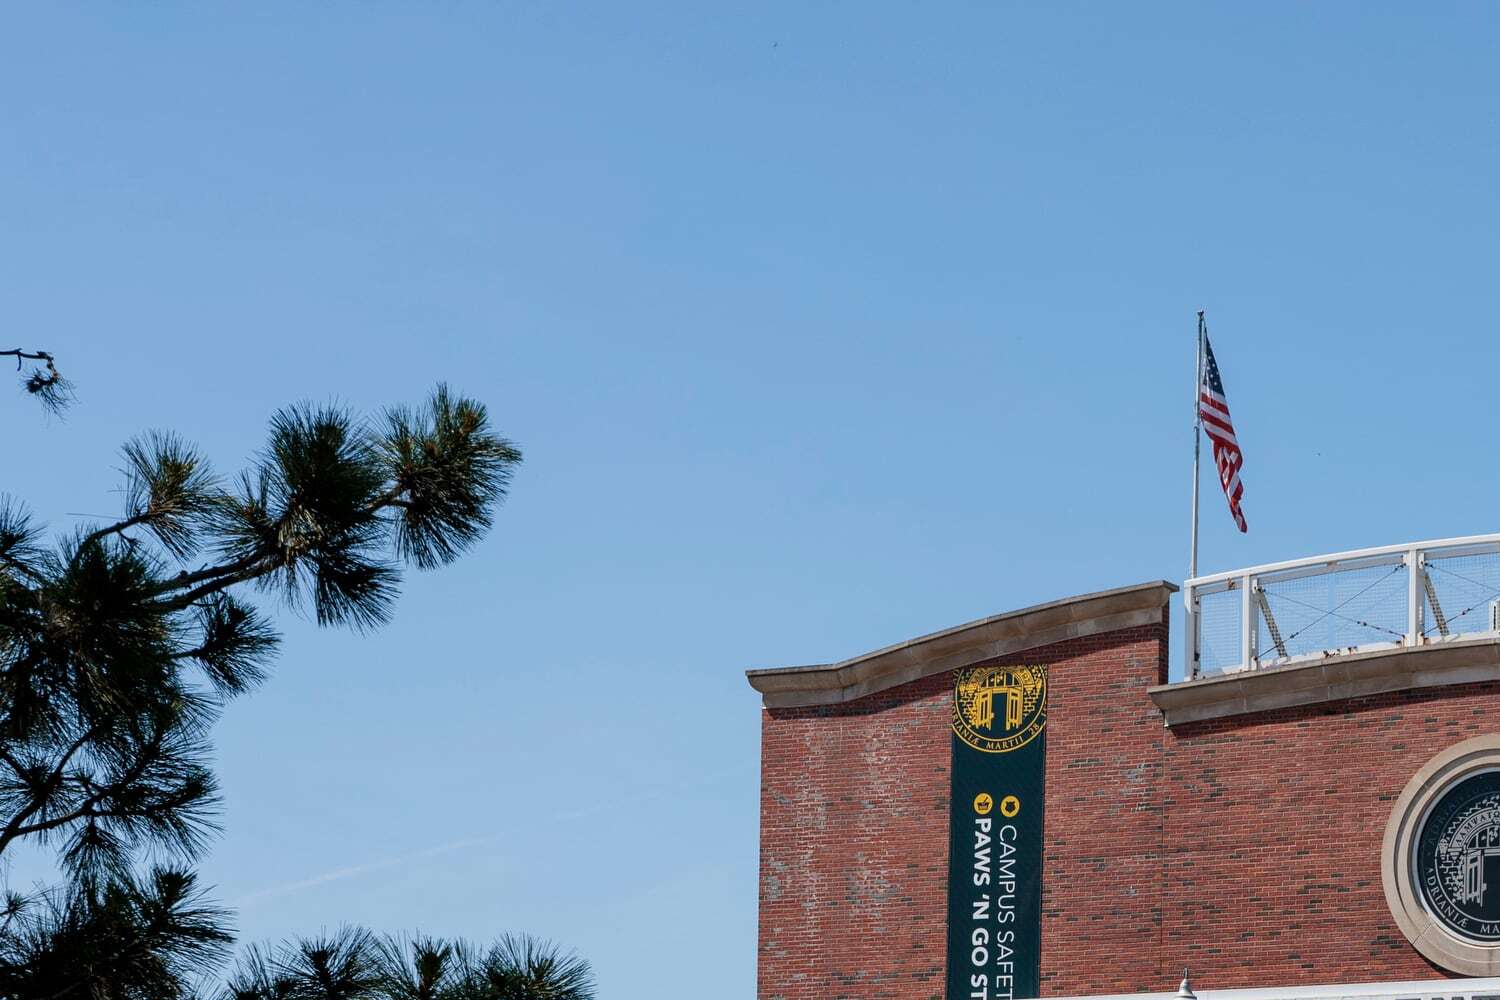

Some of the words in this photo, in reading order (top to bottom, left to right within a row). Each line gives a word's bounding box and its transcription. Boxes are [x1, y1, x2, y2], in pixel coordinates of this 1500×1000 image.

[986, 735, 1024, 749] MARTII
[973, 817, 992, 887] PAWS
[997, 824, 1017, 924] CAMPUS
[972, 893, 990, 920] 'N
[971, 927, 989, 967] GO
[995, 930, 1015, 1000] SAFET
